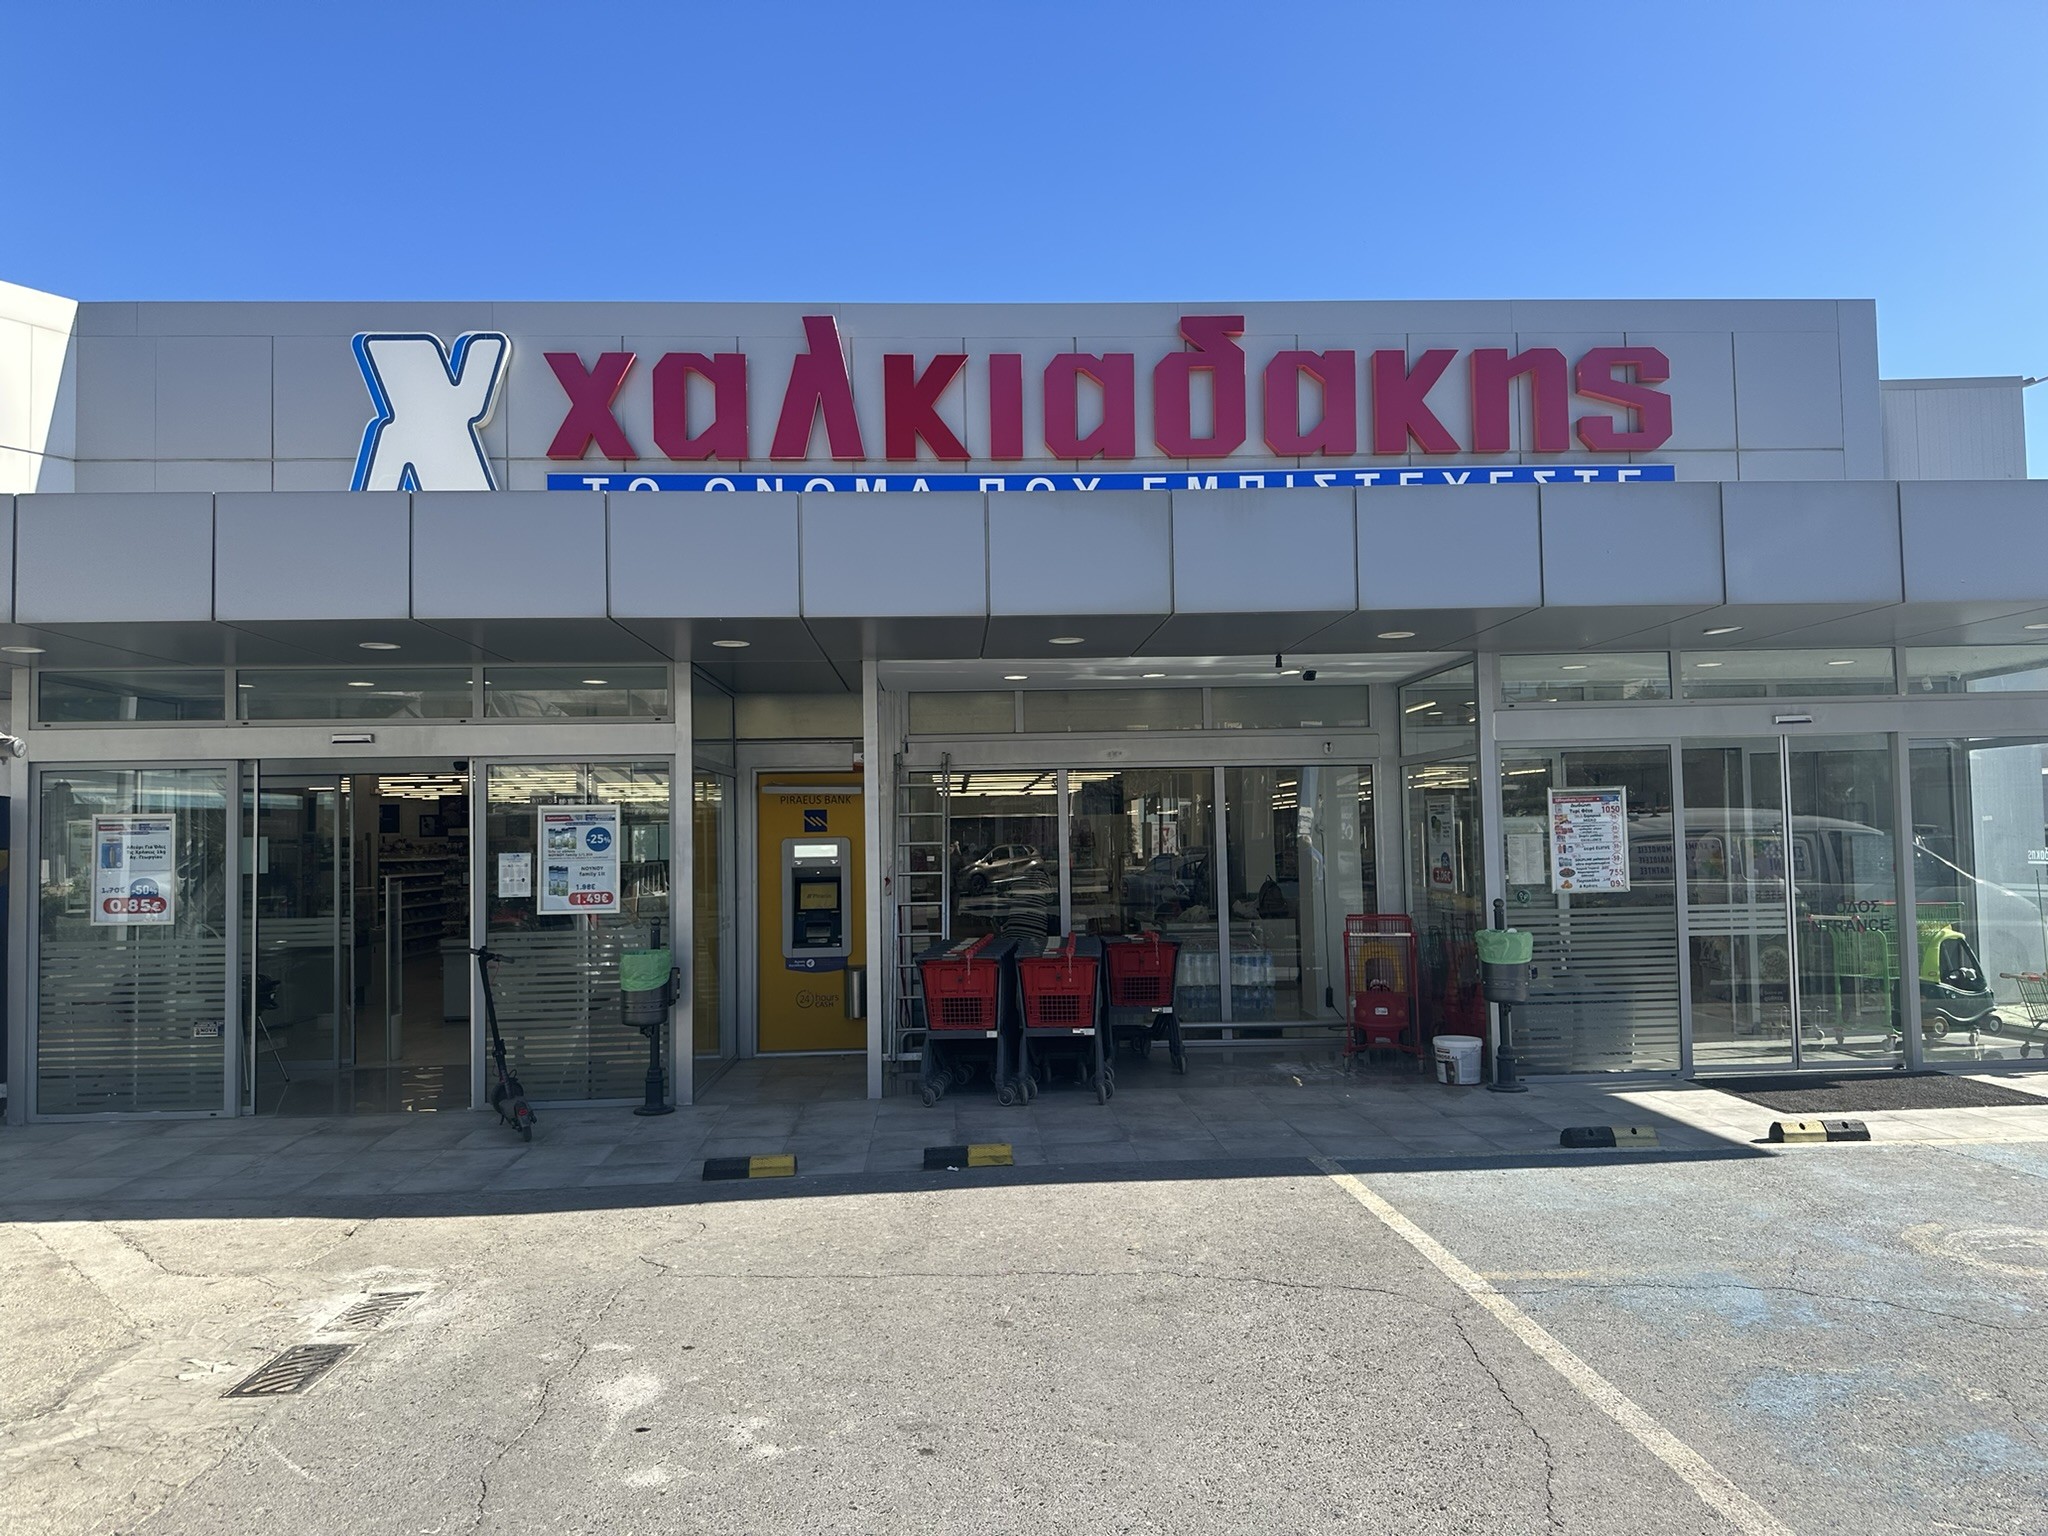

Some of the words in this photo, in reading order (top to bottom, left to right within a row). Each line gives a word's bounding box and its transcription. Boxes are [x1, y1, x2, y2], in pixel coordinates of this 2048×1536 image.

[780, 795, 821, 804] PIRAEUS
[824, 795, 851, 804] BANK
[131, 884, 158, 895] -50%
[576, 893, 609, 904] 1.49€
[110, 898, 161, 912] 0.85€
[1802, 918, 1891, 932] ENTRANCE
